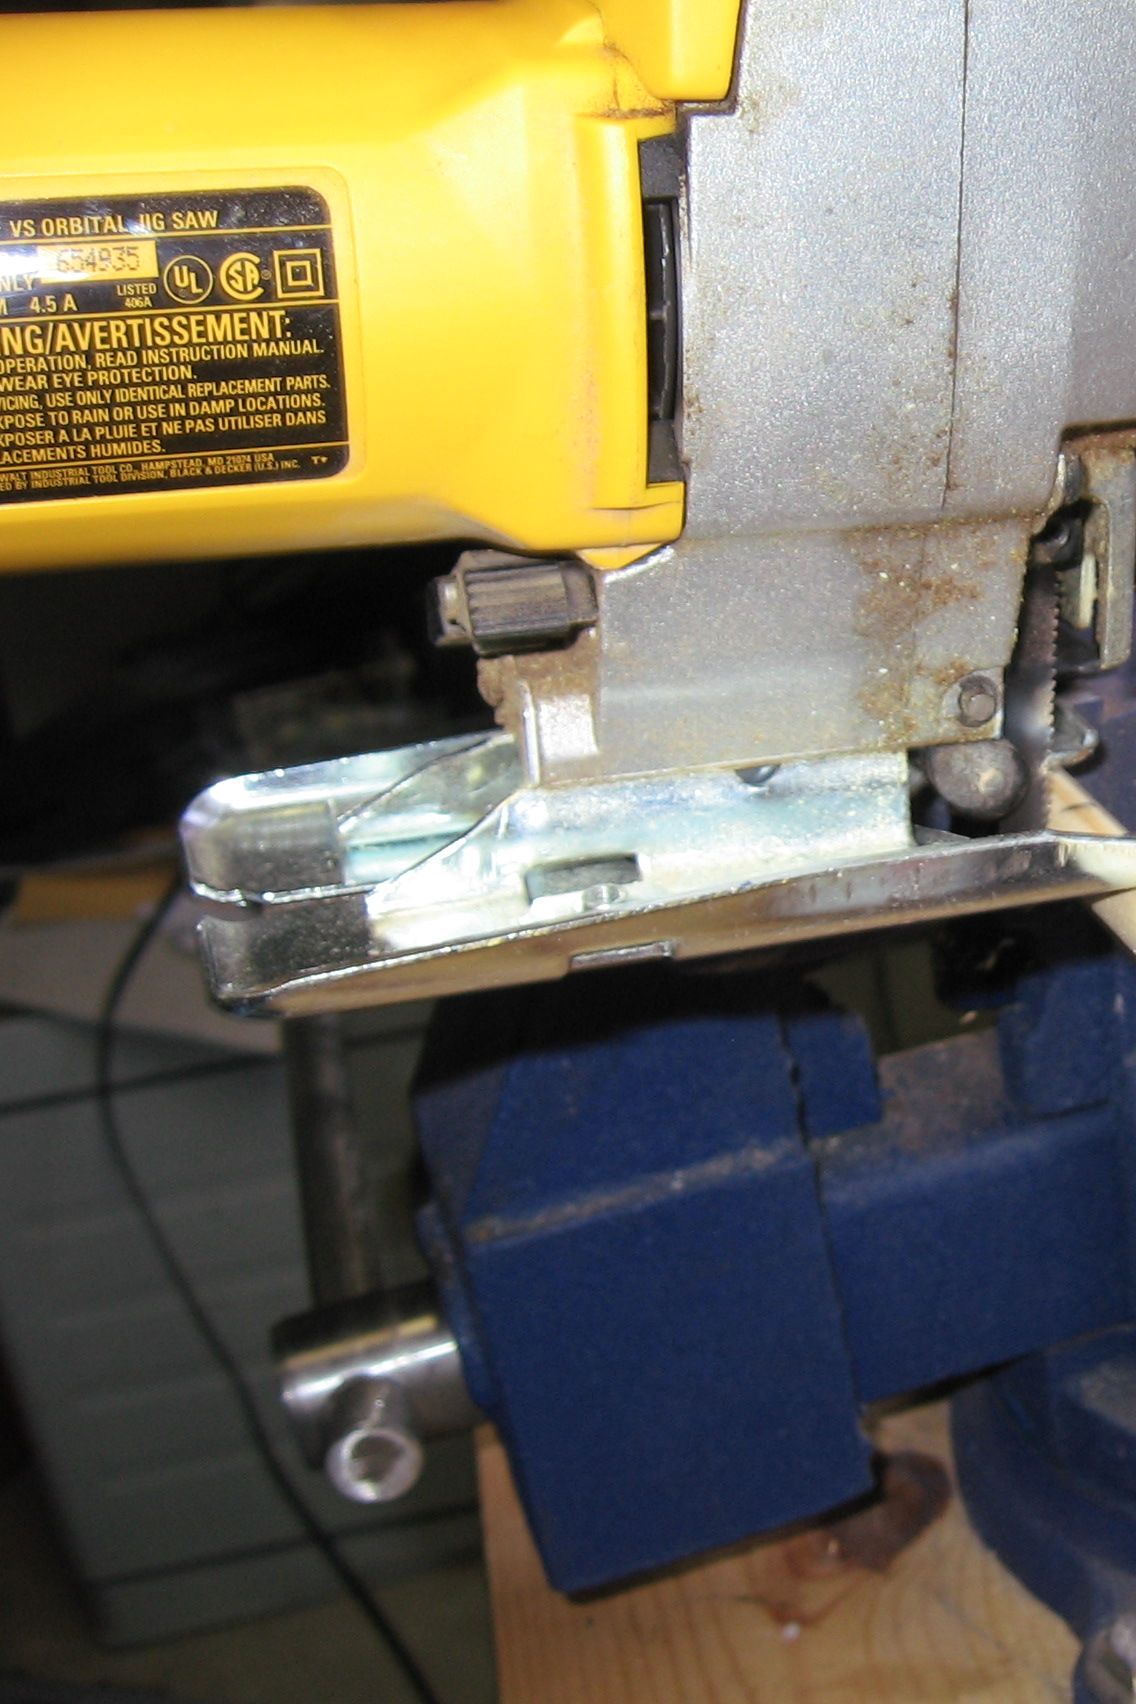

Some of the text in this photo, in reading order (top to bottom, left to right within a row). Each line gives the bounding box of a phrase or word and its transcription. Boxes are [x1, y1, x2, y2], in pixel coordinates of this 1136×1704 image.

[9, 219, 36, 238] VS
[41, 215, 129, 237] ORBITAL
[171, 209, 219, 231] SAW
[30, 295, 57, 315] 4.5
[63, 293, 78, 313] A
[116, 283, 157, 296] LISTED
[95, 350, 138, 368] READ
[143, 343, 248, 365] INSTRUCTION
[252, 339, 325, 358] MANUAL.
[0, 365, 198, 392] WEAR EYE PROTECTION.
[46, 391, 74, 407] USE
[76, 388, 112, 405] ONLY
[115, 382, 186, 403] IDENTICAL
[188, 377, 282, 398] REPLACEMENT
[286, 374, 331, 391] PARTS.
[48, 410, 69, 426] TO
[72, 407, 110, 424] RAIN
[113, 405, 134, 421] OR
[136, 403, 167, 420] USE
[169, 402, 187, 417] IN
[190, 399, 235, 415] DAMP
[238, 393, 326, 412] LOCATIONS.
[59, 429, 70, 443] A
[73, 427, 92, 442] LA
[95, 424, 138, 440] PLUIE
[141, 422, 158, 436] ET
[162, 420, 183, 435] NE
[185, 418, 215, 434] PAS
[218, 413, 282, 431] UTILISER
[286, 410, 326, 427] DANS
[91, 439, 166, 458] HUMIDES.
[15, 479, 28, 490] BY
[31, 476, 91, 489] INDUSTRIAL
[93, 473, 118, 484] TOOL
[170, 467, 201, 478] BLACK
[214, 464, 251, 475] DECKER
[281, 459, 300, 470] INC.
[31, 467, 90, 481] INDUSTRIAL
[92, 464, 117, 476] TOOL
[207, 457, 224, 467] MD
[254, 453, 275, 462] USA
